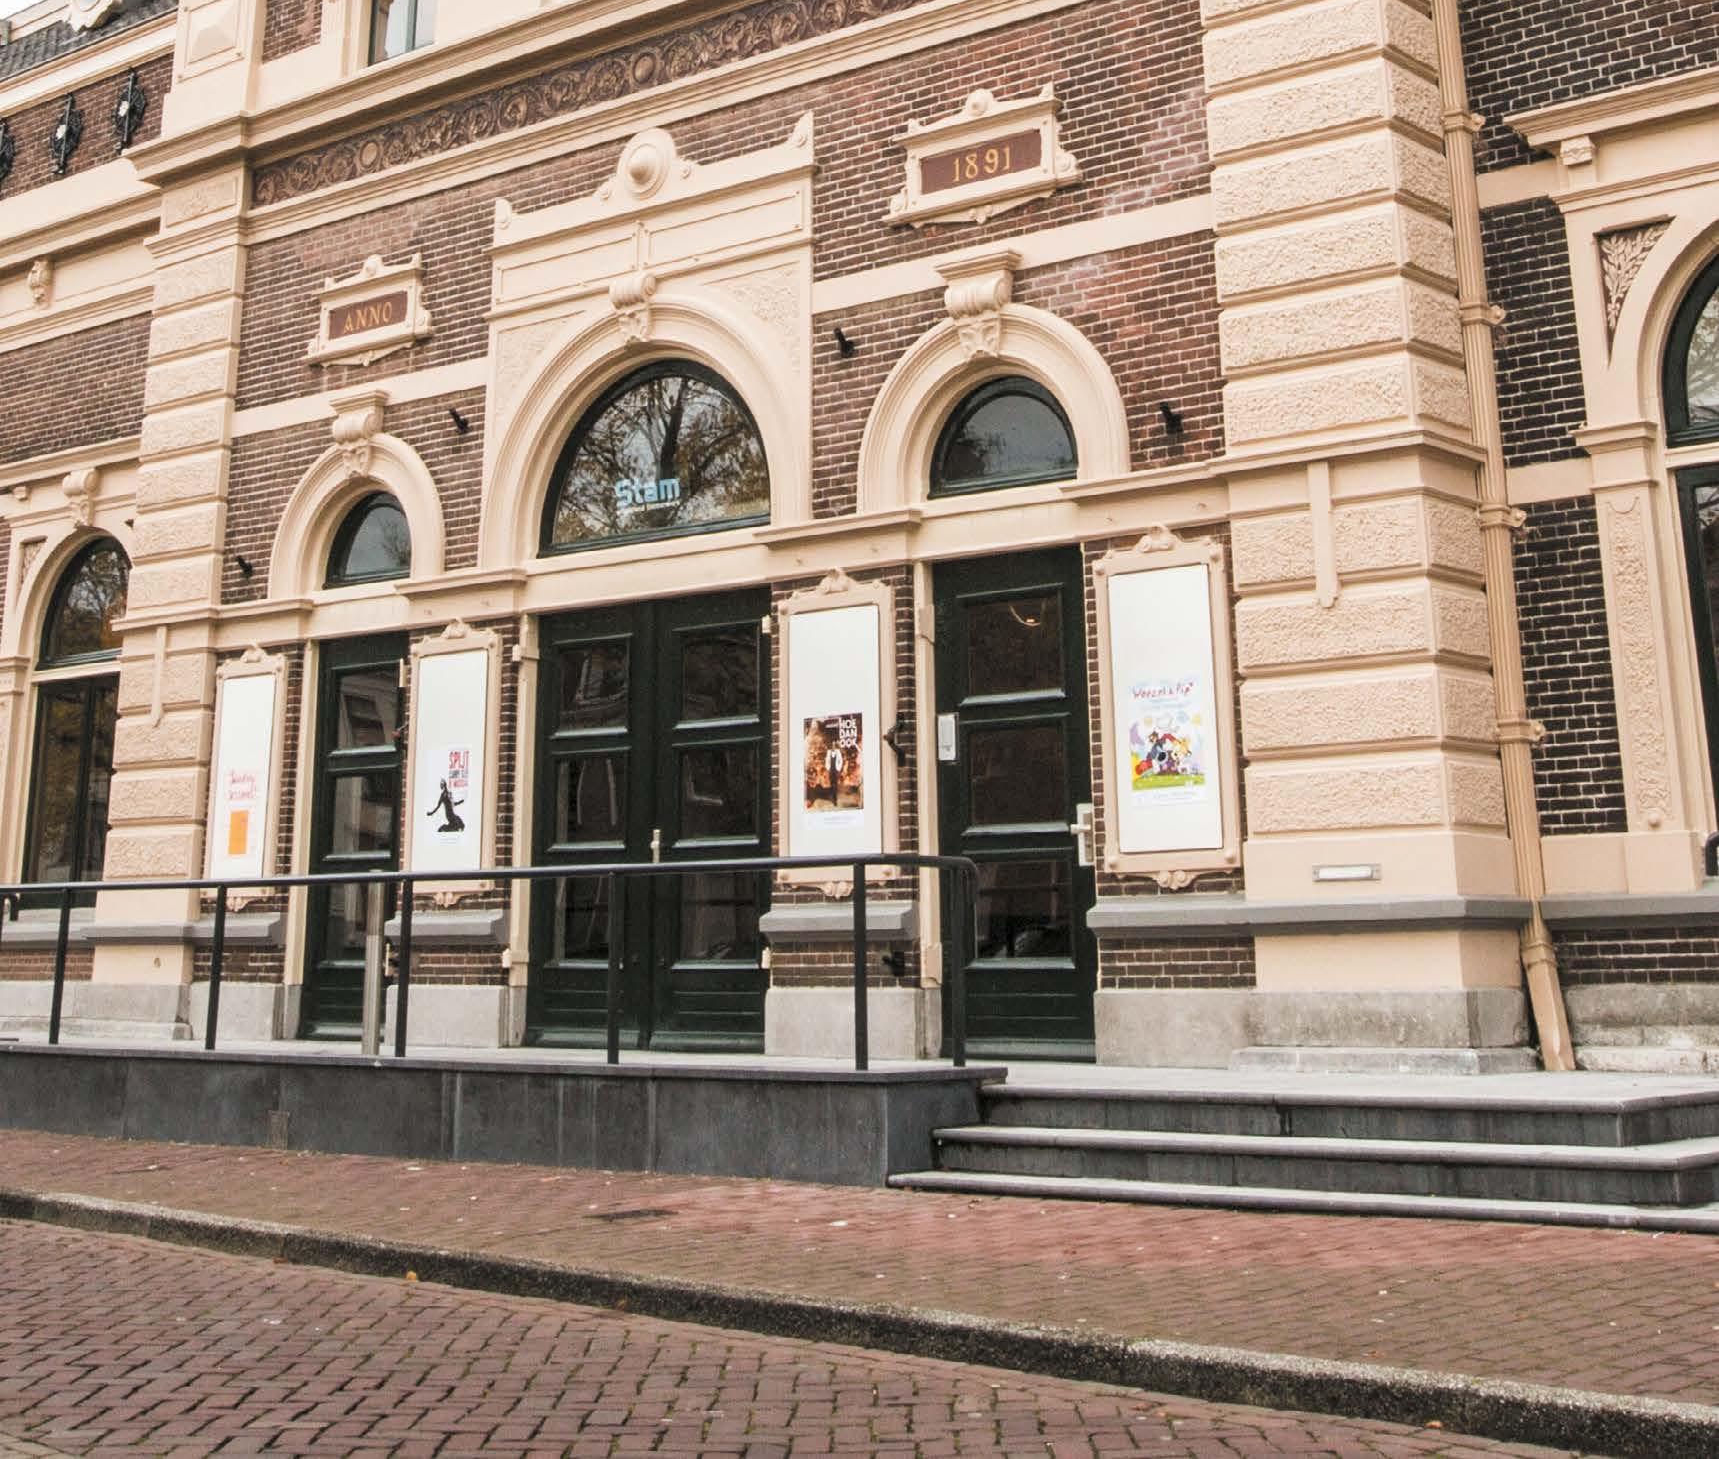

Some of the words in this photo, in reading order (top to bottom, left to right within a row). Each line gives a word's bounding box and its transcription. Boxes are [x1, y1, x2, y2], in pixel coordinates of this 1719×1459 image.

[952, 145, 1011, 183] 1891
[343, 301, 393, 334] ANNO
[615, 477, 681, 508] Stam
[839, 718, 857, 729] HOE
[839, 728, 858, 739] DAN
